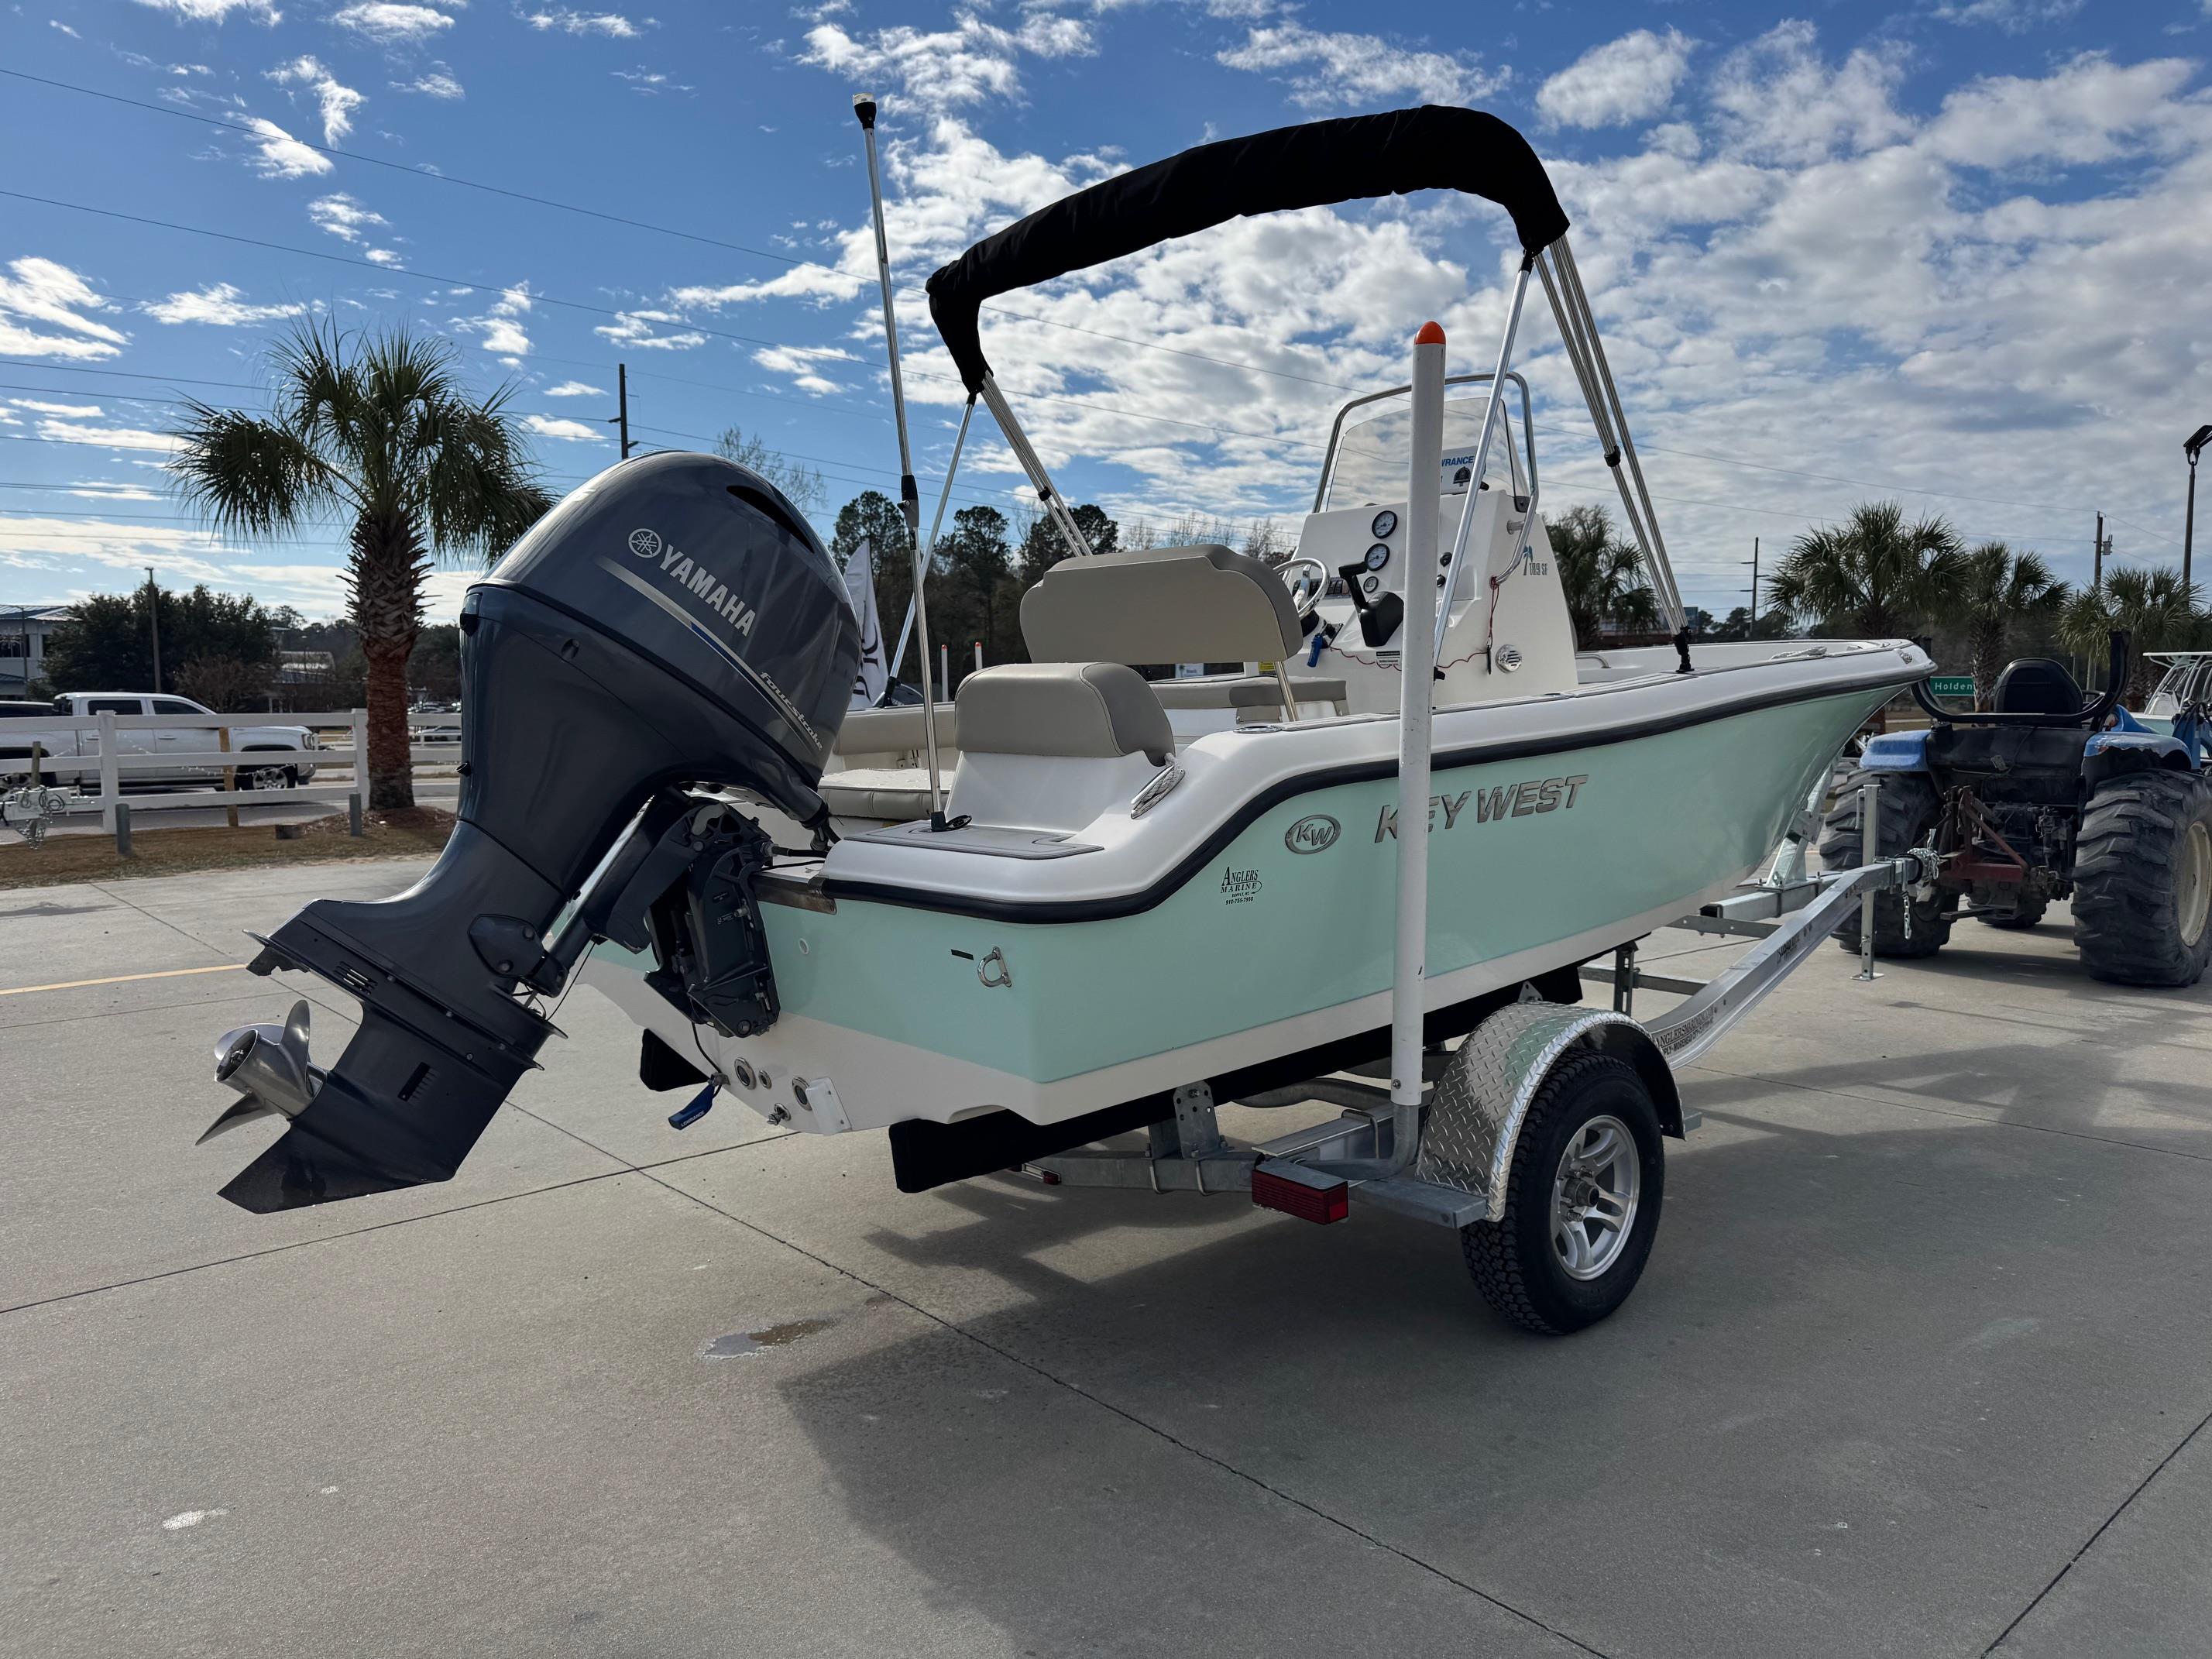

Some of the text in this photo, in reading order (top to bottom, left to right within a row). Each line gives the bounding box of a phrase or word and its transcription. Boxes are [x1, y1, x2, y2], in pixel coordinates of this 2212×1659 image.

[660, 544, 756, 637] YAMAHA
[1935, 682, 1973, 690] Holden
[1477, 775, 1589, 824] WEST
[1221, 882, 1257, 894] MARINE
